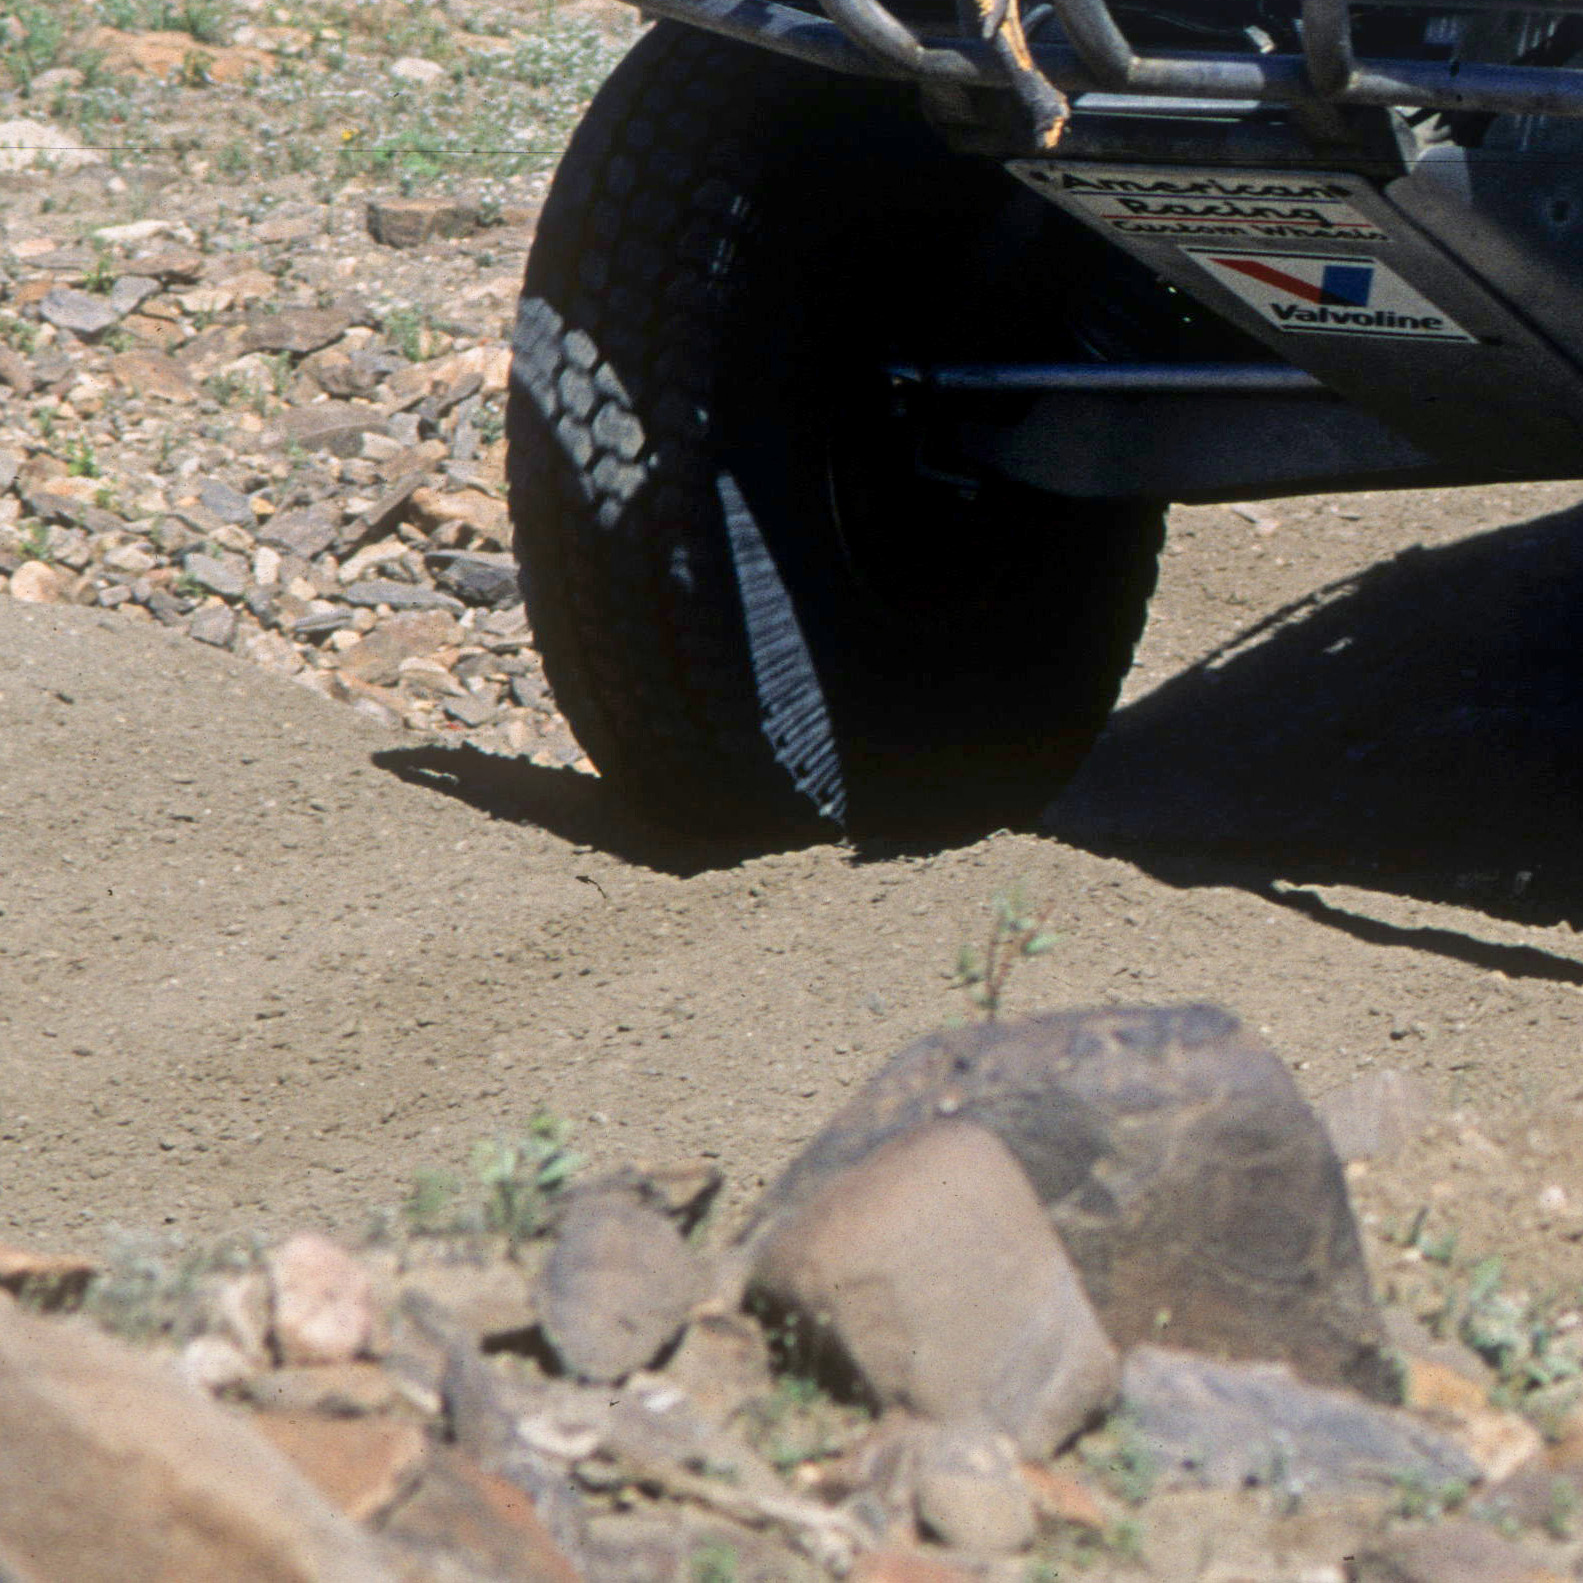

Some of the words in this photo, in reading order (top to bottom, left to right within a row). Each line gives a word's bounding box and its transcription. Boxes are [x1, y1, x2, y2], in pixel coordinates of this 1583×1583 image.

[1062, 172, 1345, 201] American
[1116, 197, 1333, 228] Racing
[1270, 301, 1445, 331] Valvoline
